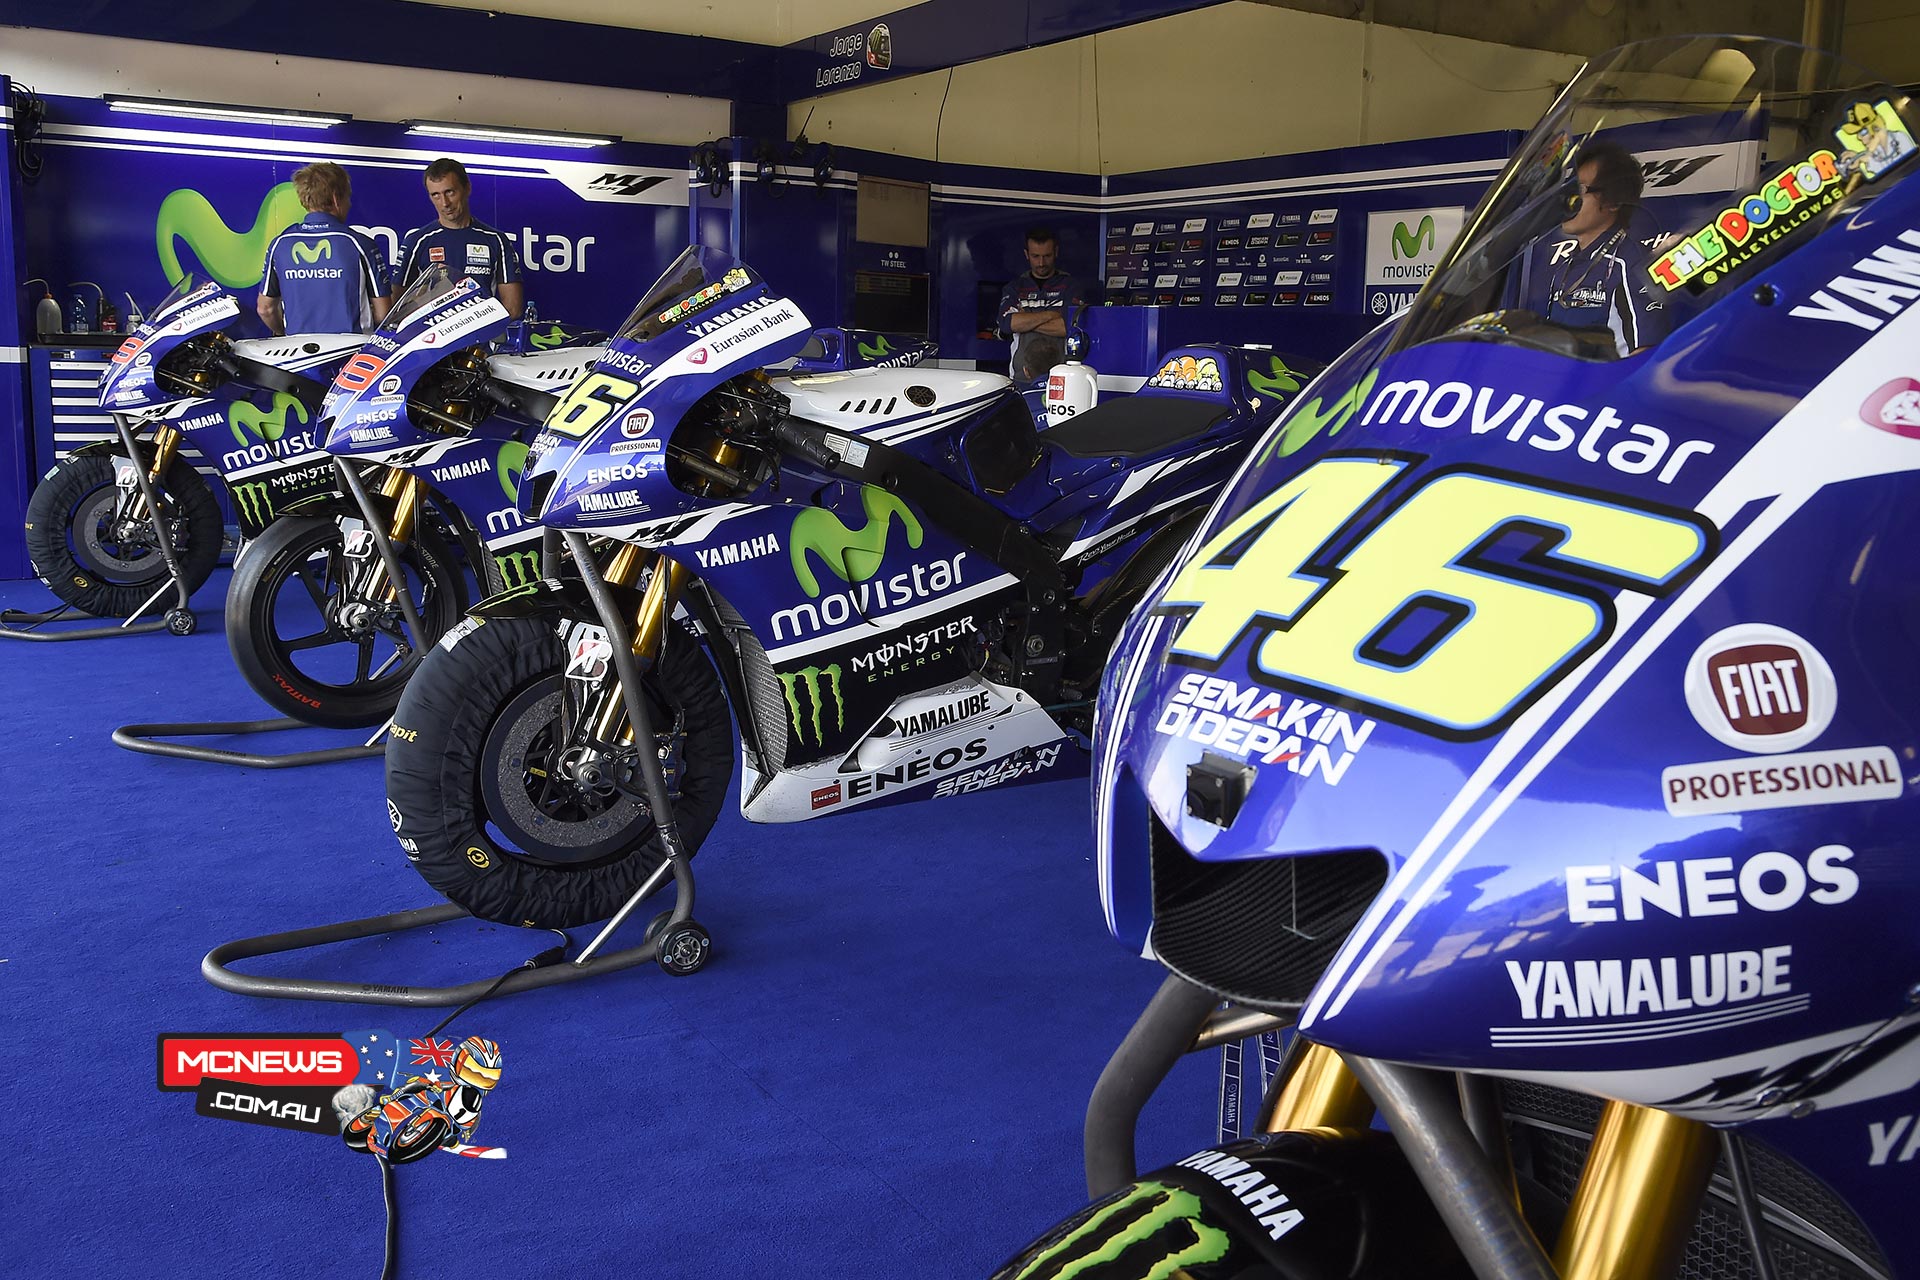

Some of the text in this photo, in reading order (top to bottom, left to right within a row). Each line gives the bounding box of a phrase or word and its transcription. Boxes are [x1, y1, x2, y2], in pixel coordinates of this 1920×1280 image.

[830, 32, 863, 57] Jorge
[815, 61, 862, 88] Lorenzo
[1648, 150, 1840, 292] THE DOCTOR
[1702, 188, 1845, 286] @VALEYELLOW46
[285, 269, 343, 280] movistar
[881, 259, 907, 269] TW STEEL
[1382, 263, 1435, 278] movista
[423, 295, 487, 327] YAMAHA
[438, 305, 498, 337] Eurasian Bank
[686, 296, 777, 338] YAMAHA
[368, 334, 400, 352] ovistar
[710, 306, 795, 354] Eurasian Bank
[601, 348, 652, 376] ovistar
[178, 412, 224, 432] YAMAHA
[356, 410, 397, 425] ENEOS
[628, 416, 648, 432] FIAT
[1360, 379, 1716, 484] movistar
[222, 430, 315, 470] movist
[349, 426, 393, 443] YAMALUBE
[610, 441, 660, 454] PROFESSIONAL
[271, 463, 336, 489] MONSTE
[431, 457, 491, 482] YAMAHA
[587, 463, 648, 485] ENEOS
[576, 489, 643, 513] YAMALUBE
[696, 533, 780, 568] YAMAHA
[770, 551, 967, 641] movistar
[1156, 454, 1718, 740] 46
[850, 615, 978, 673] MONSTER
[867, 645, 956, 684] ENERGY
[1716, 657, 1803, 721] FIAT
[895, 690, 992, 738] YAMALUBE
[1178, 672, 1377, 752] SEMAKIN
[848, 737, 988, 800] ENEOS
[1668, 756, 1897, 803] PROFESSIONAL
[813, 791, 840, 803] ENEOS
[1564, 844, 1860, 924] ENEOS
[371, 984, 409, 995] YAMAHA
[1504, 944, 1793, 1020] YAMALUBE
[1227, 1091, 1237, 1124] YAMAHA
[1176, 1149, 1305, 1242] YAMAHA
